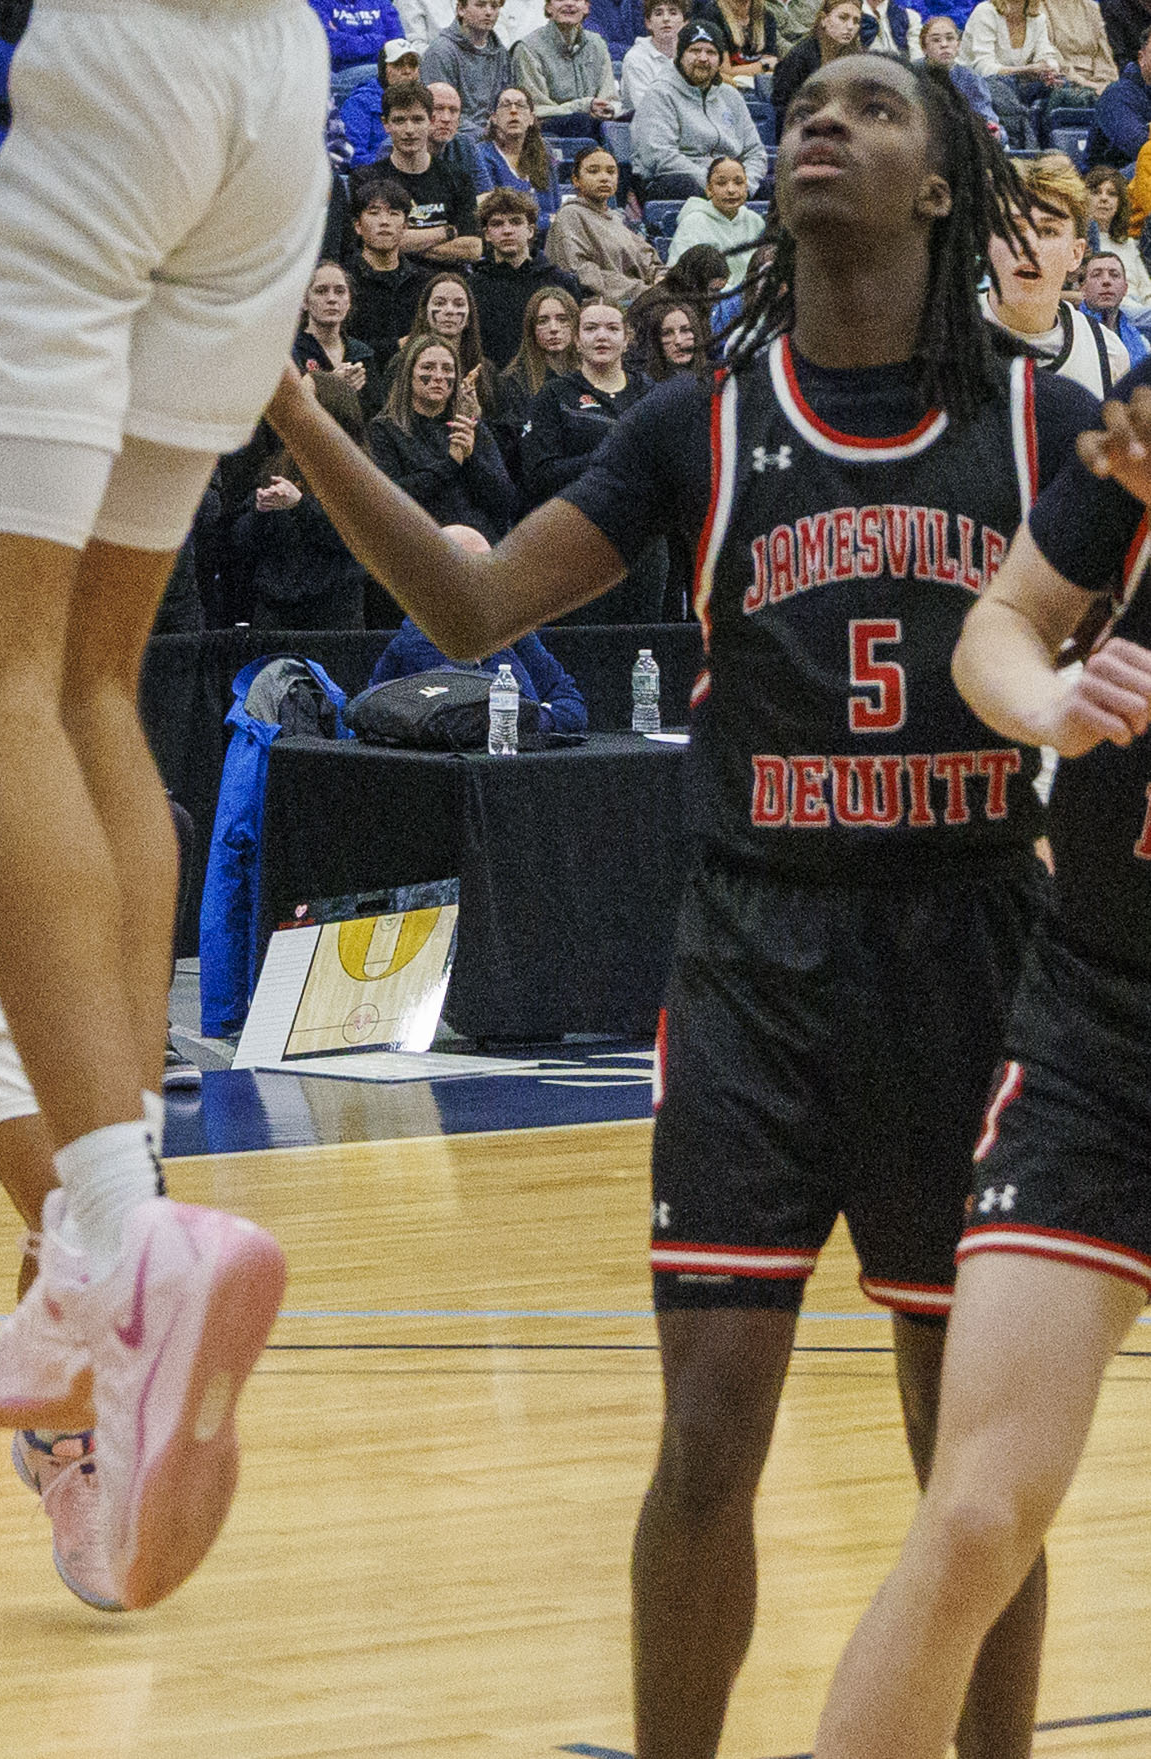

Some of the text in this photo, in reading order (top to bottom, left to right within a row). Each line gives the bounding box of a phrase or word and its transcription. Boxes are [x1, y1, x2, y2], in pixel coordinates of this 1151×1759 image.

[743, 504, 1008, 615] JAMESVILLE
[848, 619, 905, 733] 5
[751, 749, 1020, 828] DEWITT
